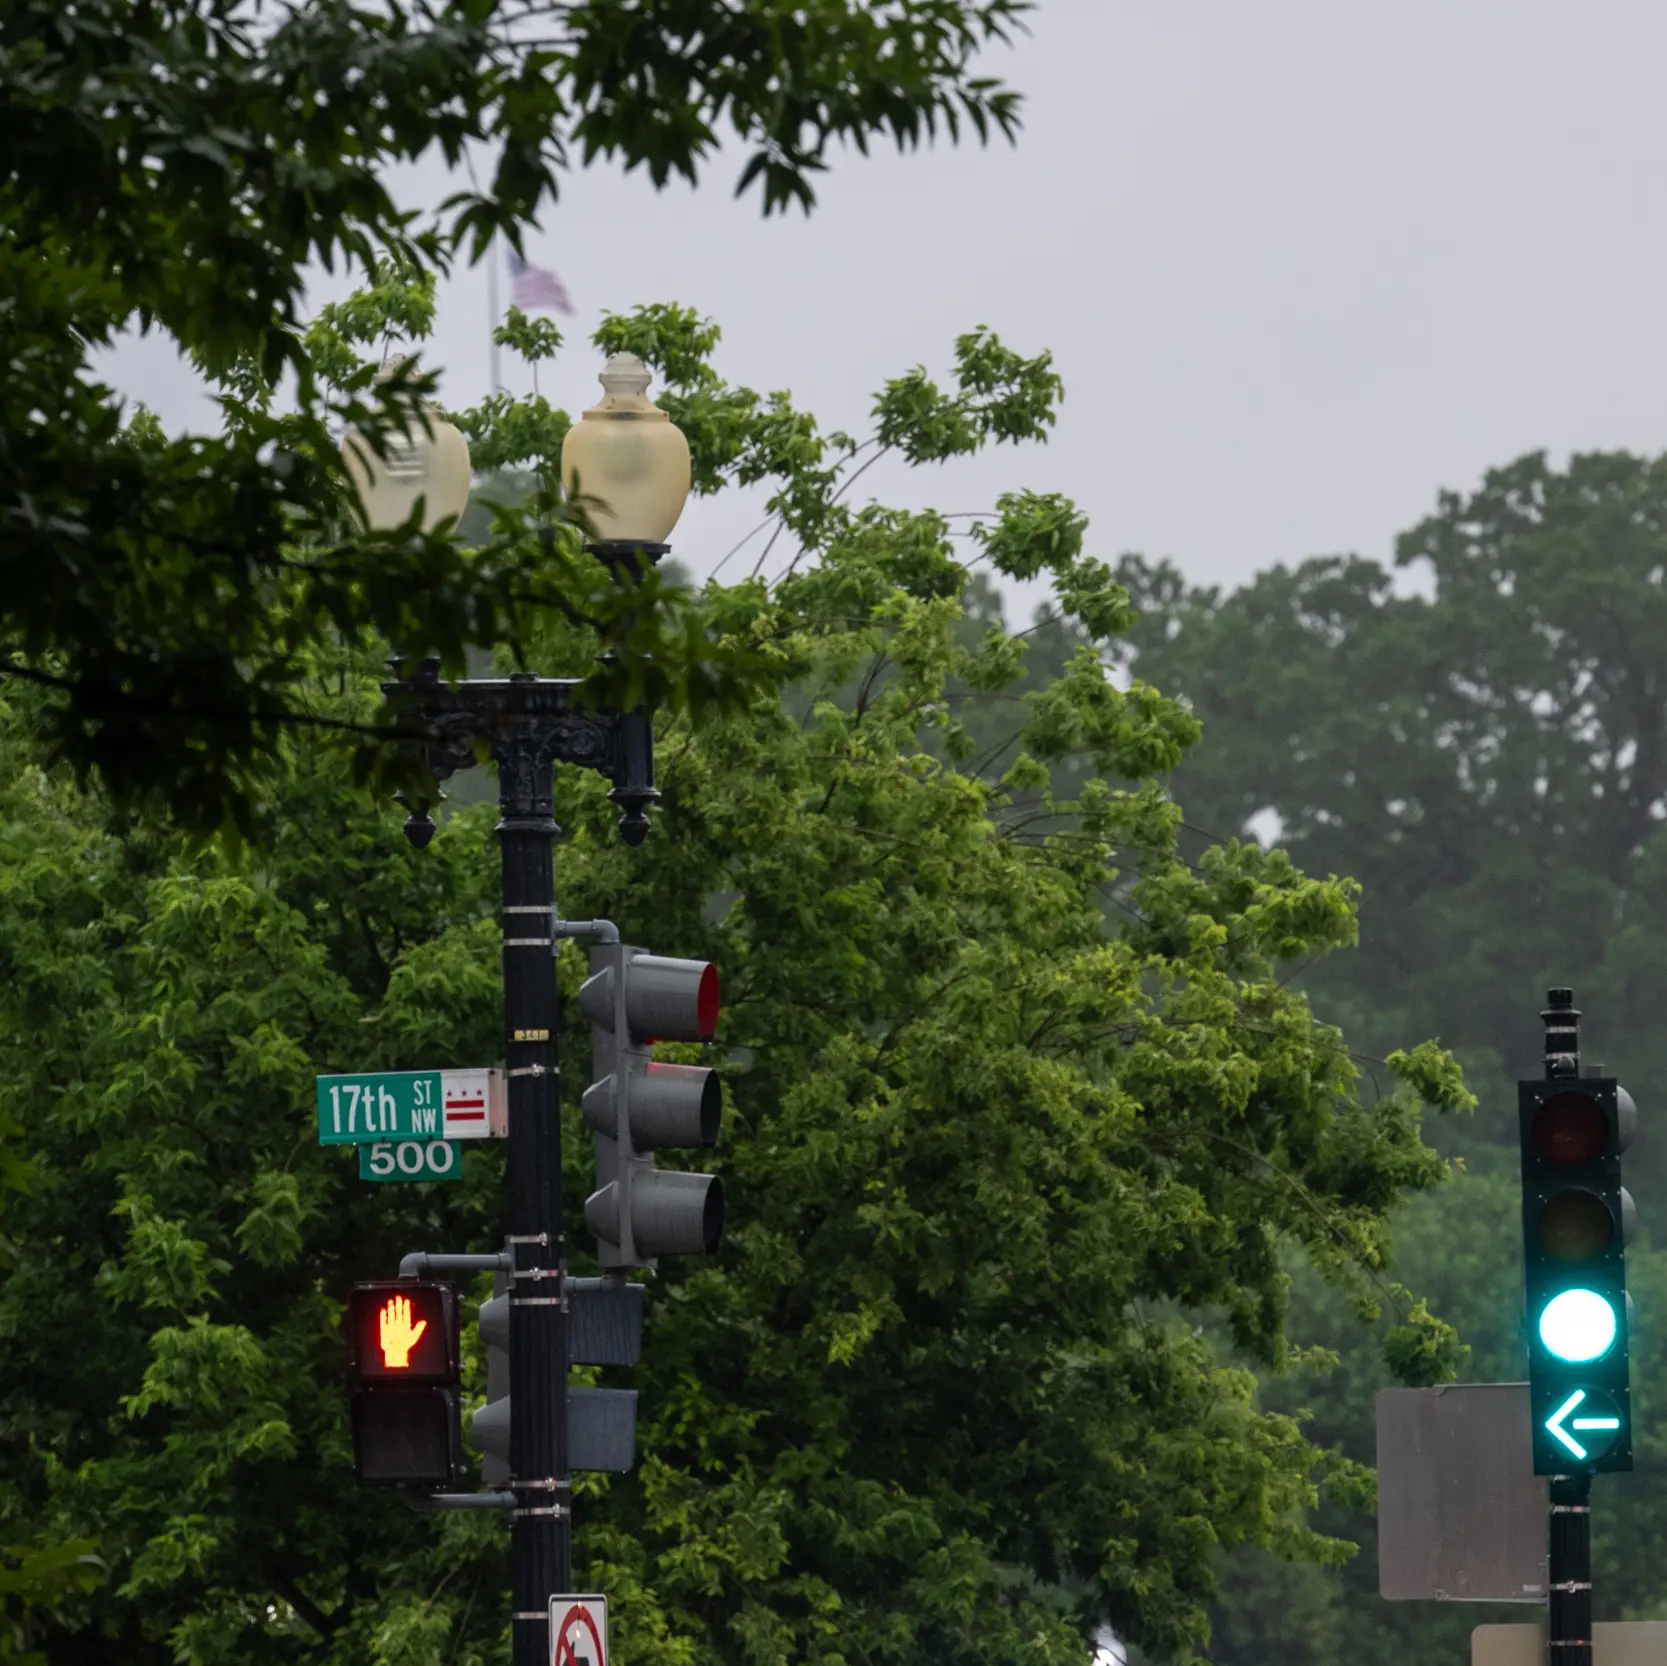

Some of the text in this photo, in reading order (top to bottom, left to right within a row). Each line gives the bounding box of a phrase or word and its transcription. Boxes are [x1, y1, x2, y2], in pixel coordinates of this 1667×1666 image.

[329, 1080, 433, 1134] 17th ST
[411, 1108, 437, 1133] NW
[369, 1141, 454, 1175] 500
